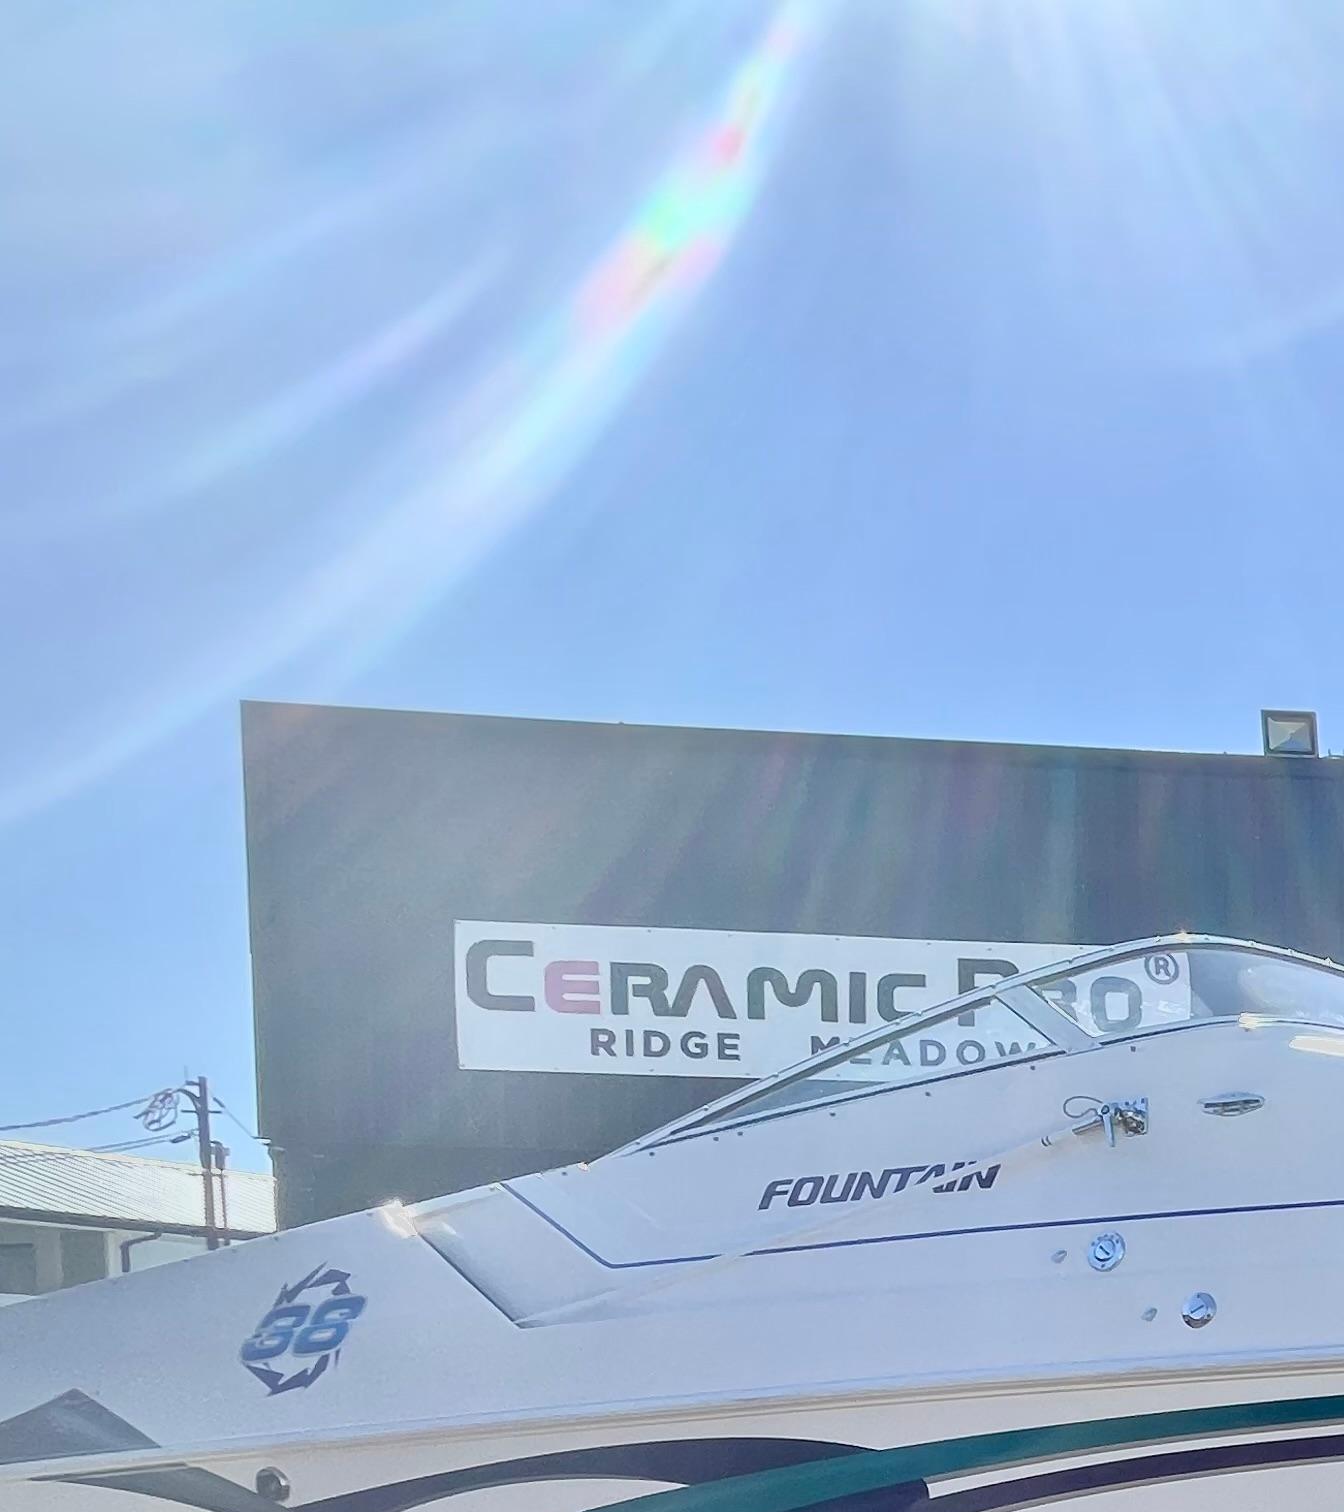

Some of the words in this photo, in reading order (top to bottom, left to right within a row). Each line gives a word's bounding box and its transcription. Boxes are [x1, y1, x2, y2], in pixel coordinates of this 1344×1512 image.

[465, 938, 927, 1024] CERAMIC
[590, 1028, 742, 1062] RIDGE
[758, 1163, 1001, 1212] FOUNTAIN
